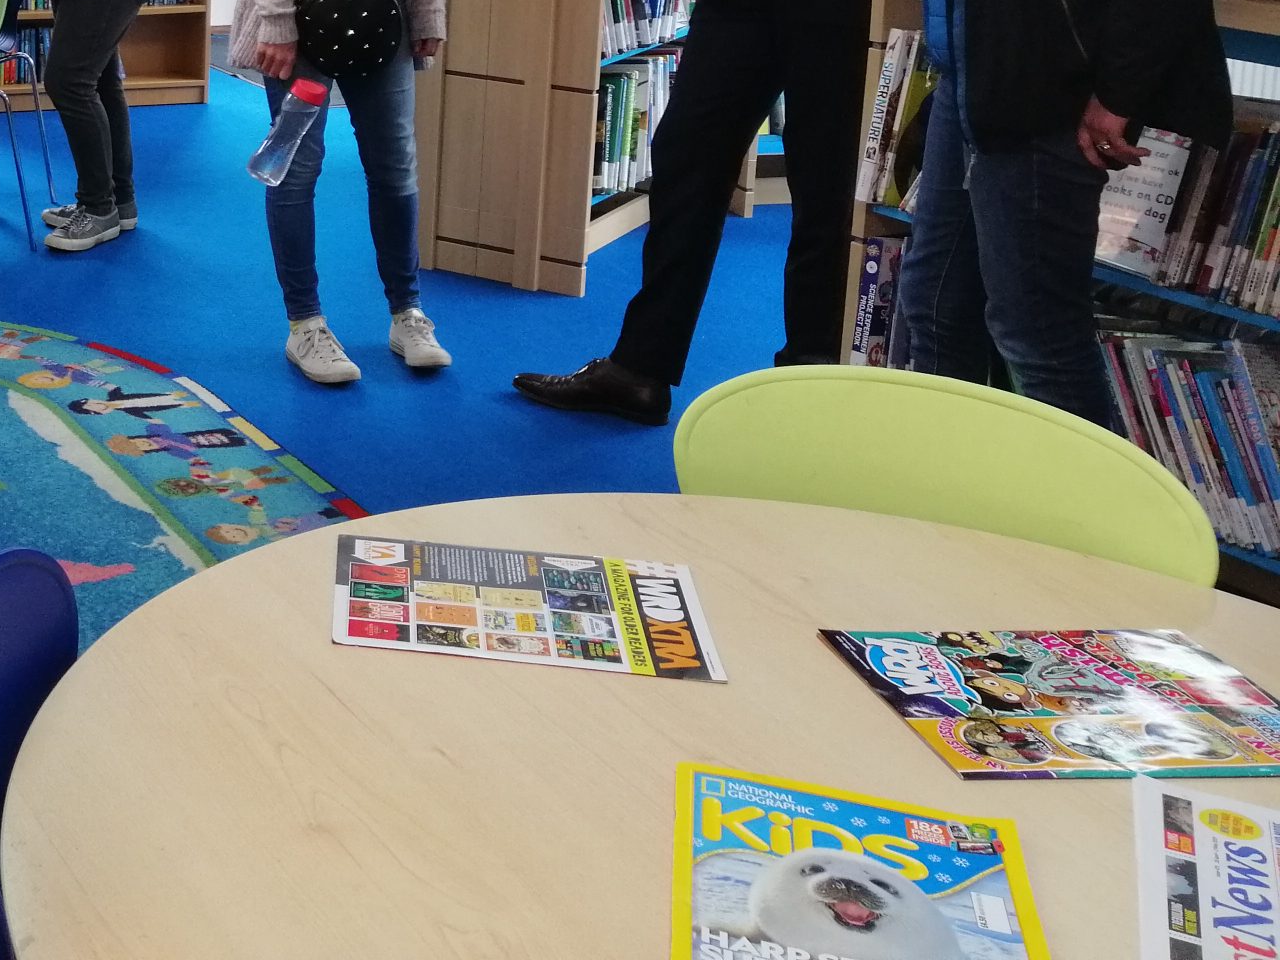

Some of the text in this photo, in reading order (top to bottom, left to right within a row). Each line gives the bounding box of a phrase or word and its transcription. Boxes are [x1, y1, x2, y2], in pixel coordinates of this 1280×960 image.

[868, 61, 894, 146] SUPERNATURE
[1105, 184, 1174, 206] ooks on CD
[1144, 206, 1166, 223] dog
[857, 295, 867, 326] PROJECT
[860, 283, 877, 354] SCIENCE EXPERIMEN
[610, 568, 630, 601] MAGAZINE
[618, 602, 634, 615] FOR
[1070, 637, 1158, 684] back!
[728, 781, 796, 804] NATIONAL
[728, 790, 815, 816] GEOGRAPHIC
[909, 820, 943, 834] 186
